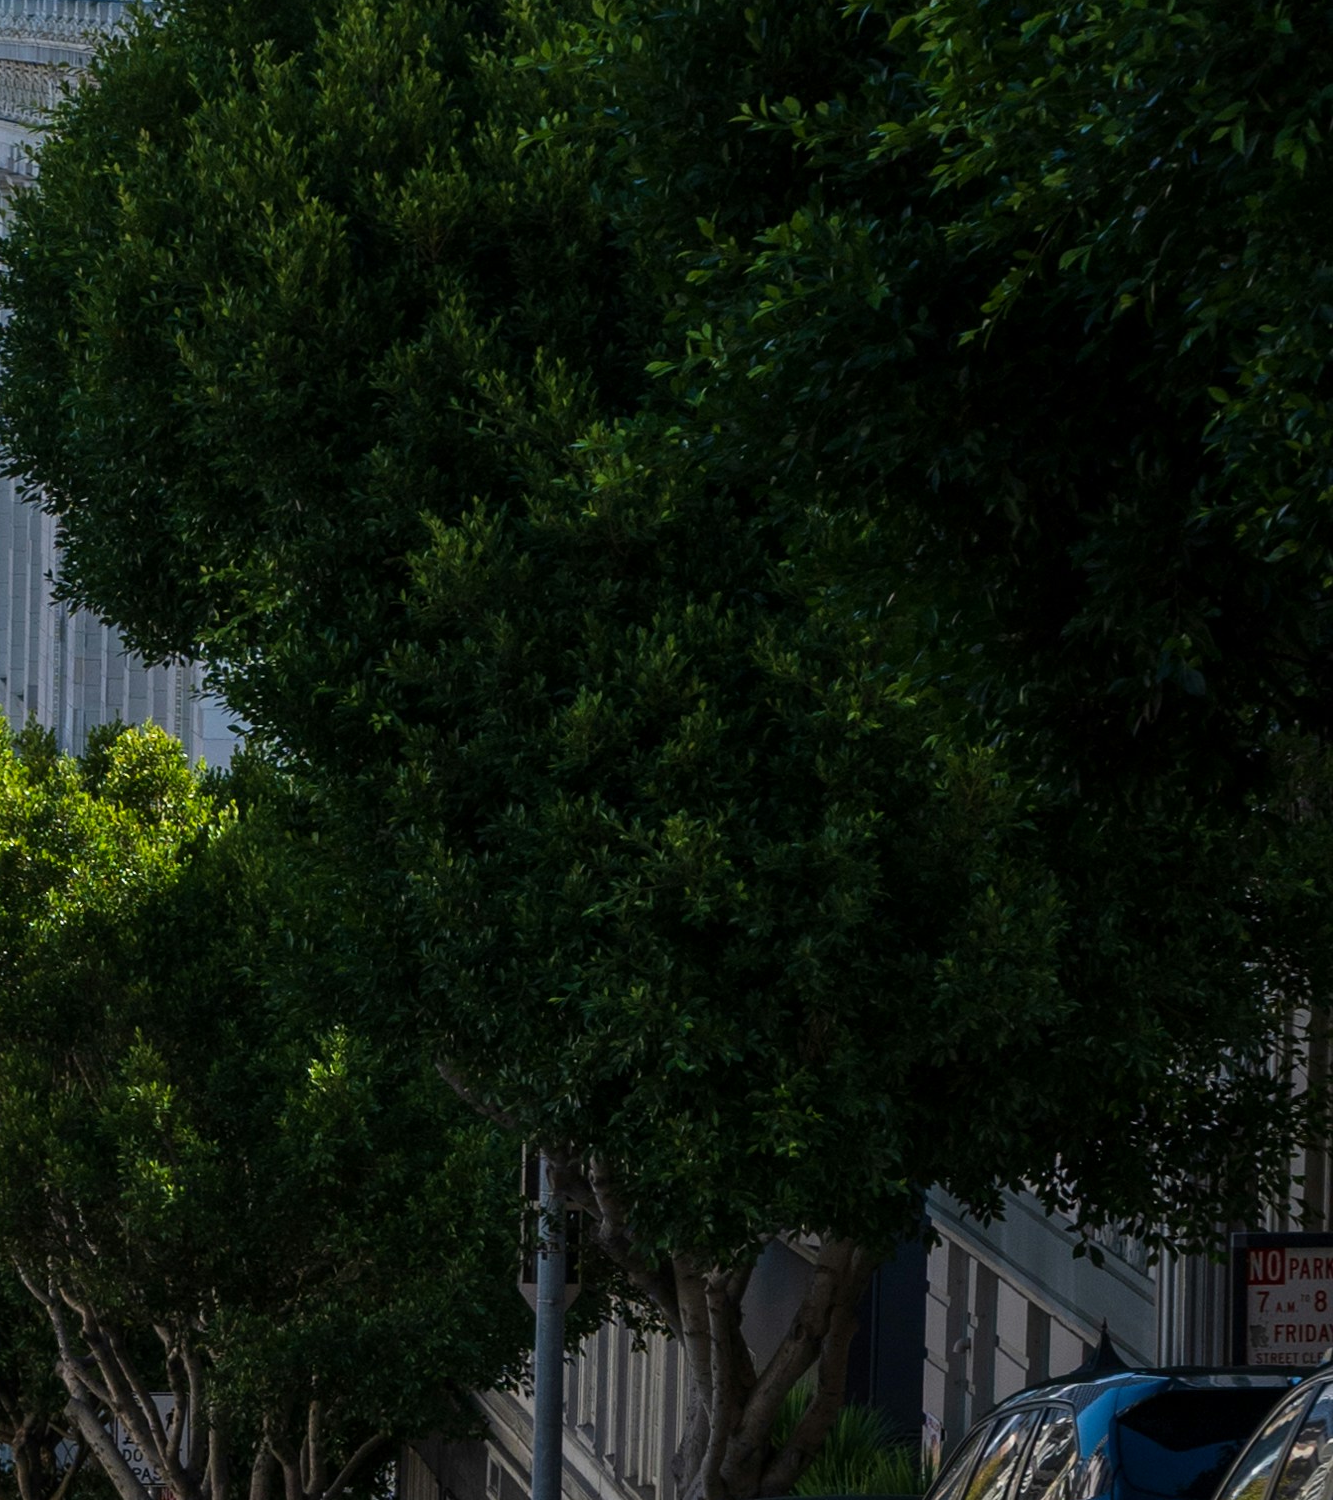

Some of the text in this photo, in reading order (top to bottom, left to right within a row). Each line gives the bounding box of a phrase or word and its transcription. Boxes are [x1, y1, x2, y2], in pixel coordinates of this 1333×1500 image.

[1250, 1250, 1282, 1281] NO
[1257, 1290, 1270, 1313] 7
[1314, 1290, 1328, 1313] 8
[1256, 1352, 1300, 1365] STREET
